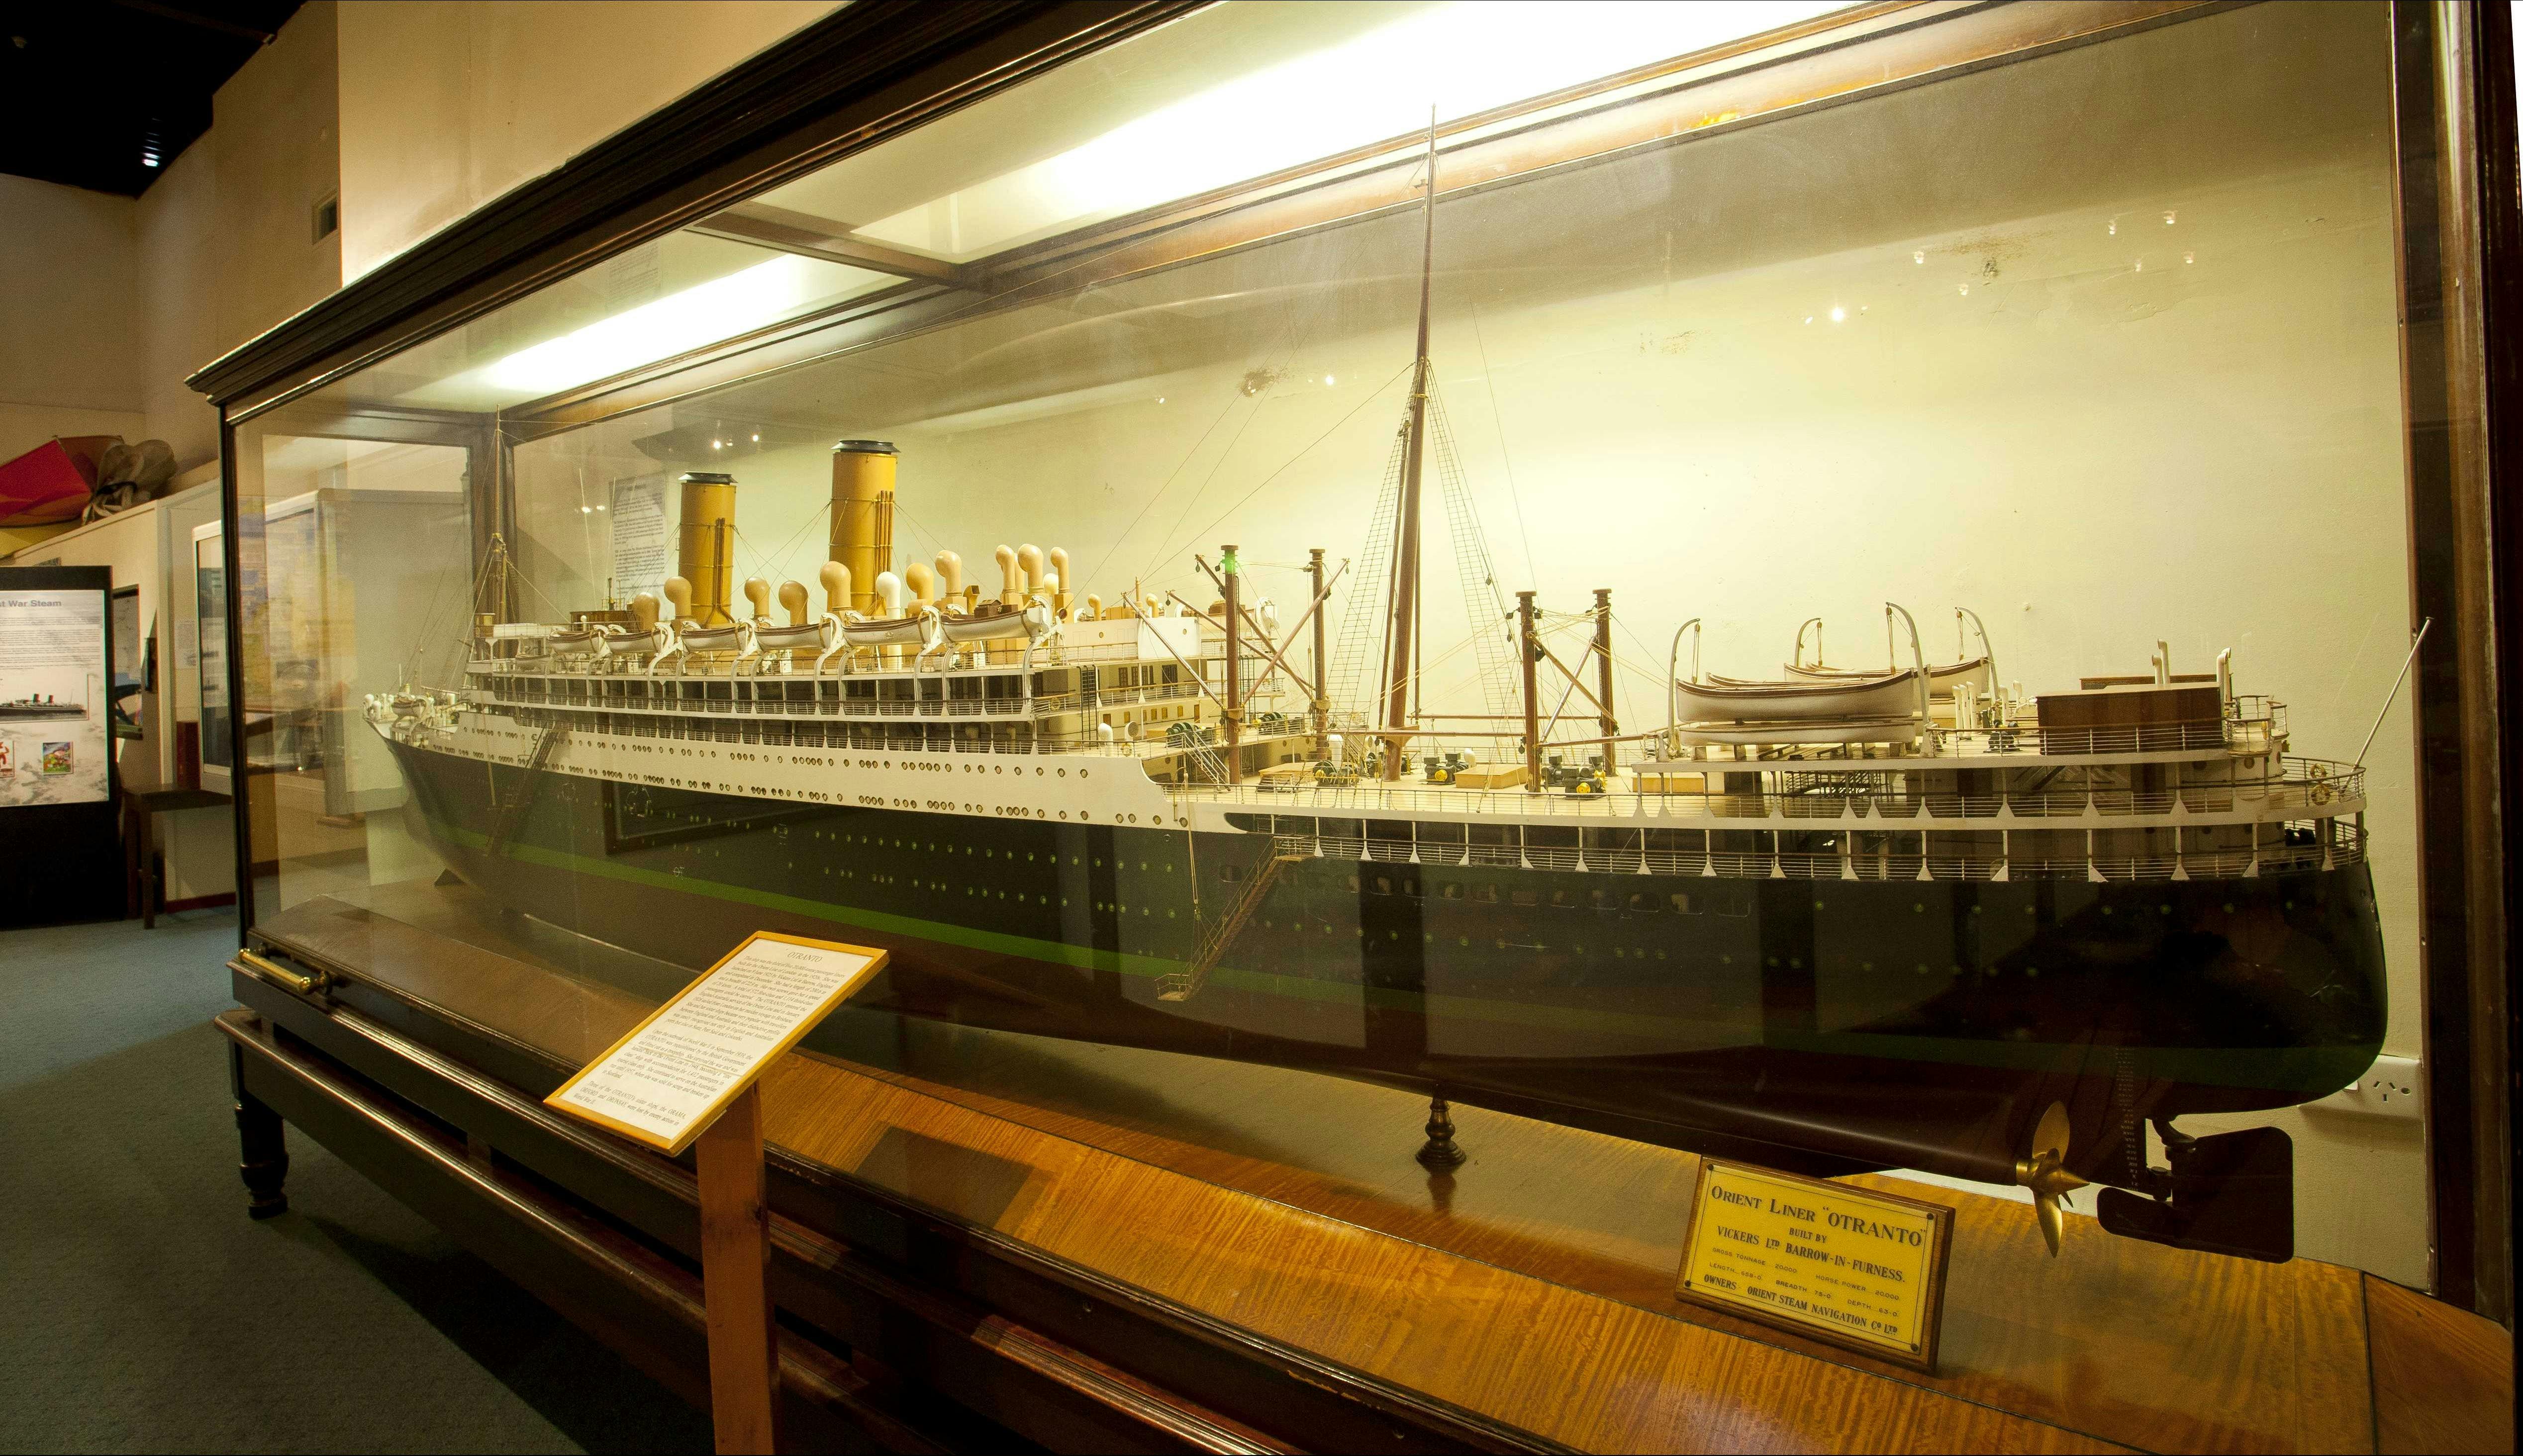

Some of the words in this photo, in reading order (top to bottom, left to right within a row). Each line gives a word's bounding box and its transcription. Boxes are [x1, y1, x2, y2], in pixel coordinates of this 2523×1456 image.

[787, 951, 823, 963] OTRANTO
[1711, 1185, 1761, 1209] ORIENT
[1769, 1198, 1815, 1222] LINER
[1717, 1226, 1759, 1245] VICKERS
[1789, 1228, 1813, 1240] BUILT
[1815, 1234, 1827, 1244] BY
[1709, 1262, 1735, 1273] LENGTH
[1776, 1280, 1807, 1292] BREADTH
[1847, 1299, 1871, 1309] DEPTH
[1712, 1247, 1733, 1257] GROSS
[1736, 1254, 1766, 1265] TONNAGE
[1816, 1274, 1839, 1284] HORSE
[1842, 1280, 1866, 1291] POWER
[1704, 1274, 1737, 1290] OWNERS
[1747, 1286, 1776, 1301] ORIENT
[1779, 1294, 1807, 1310] STEAM
[1812, 1303, 1867, 1327] NAVIGATION
